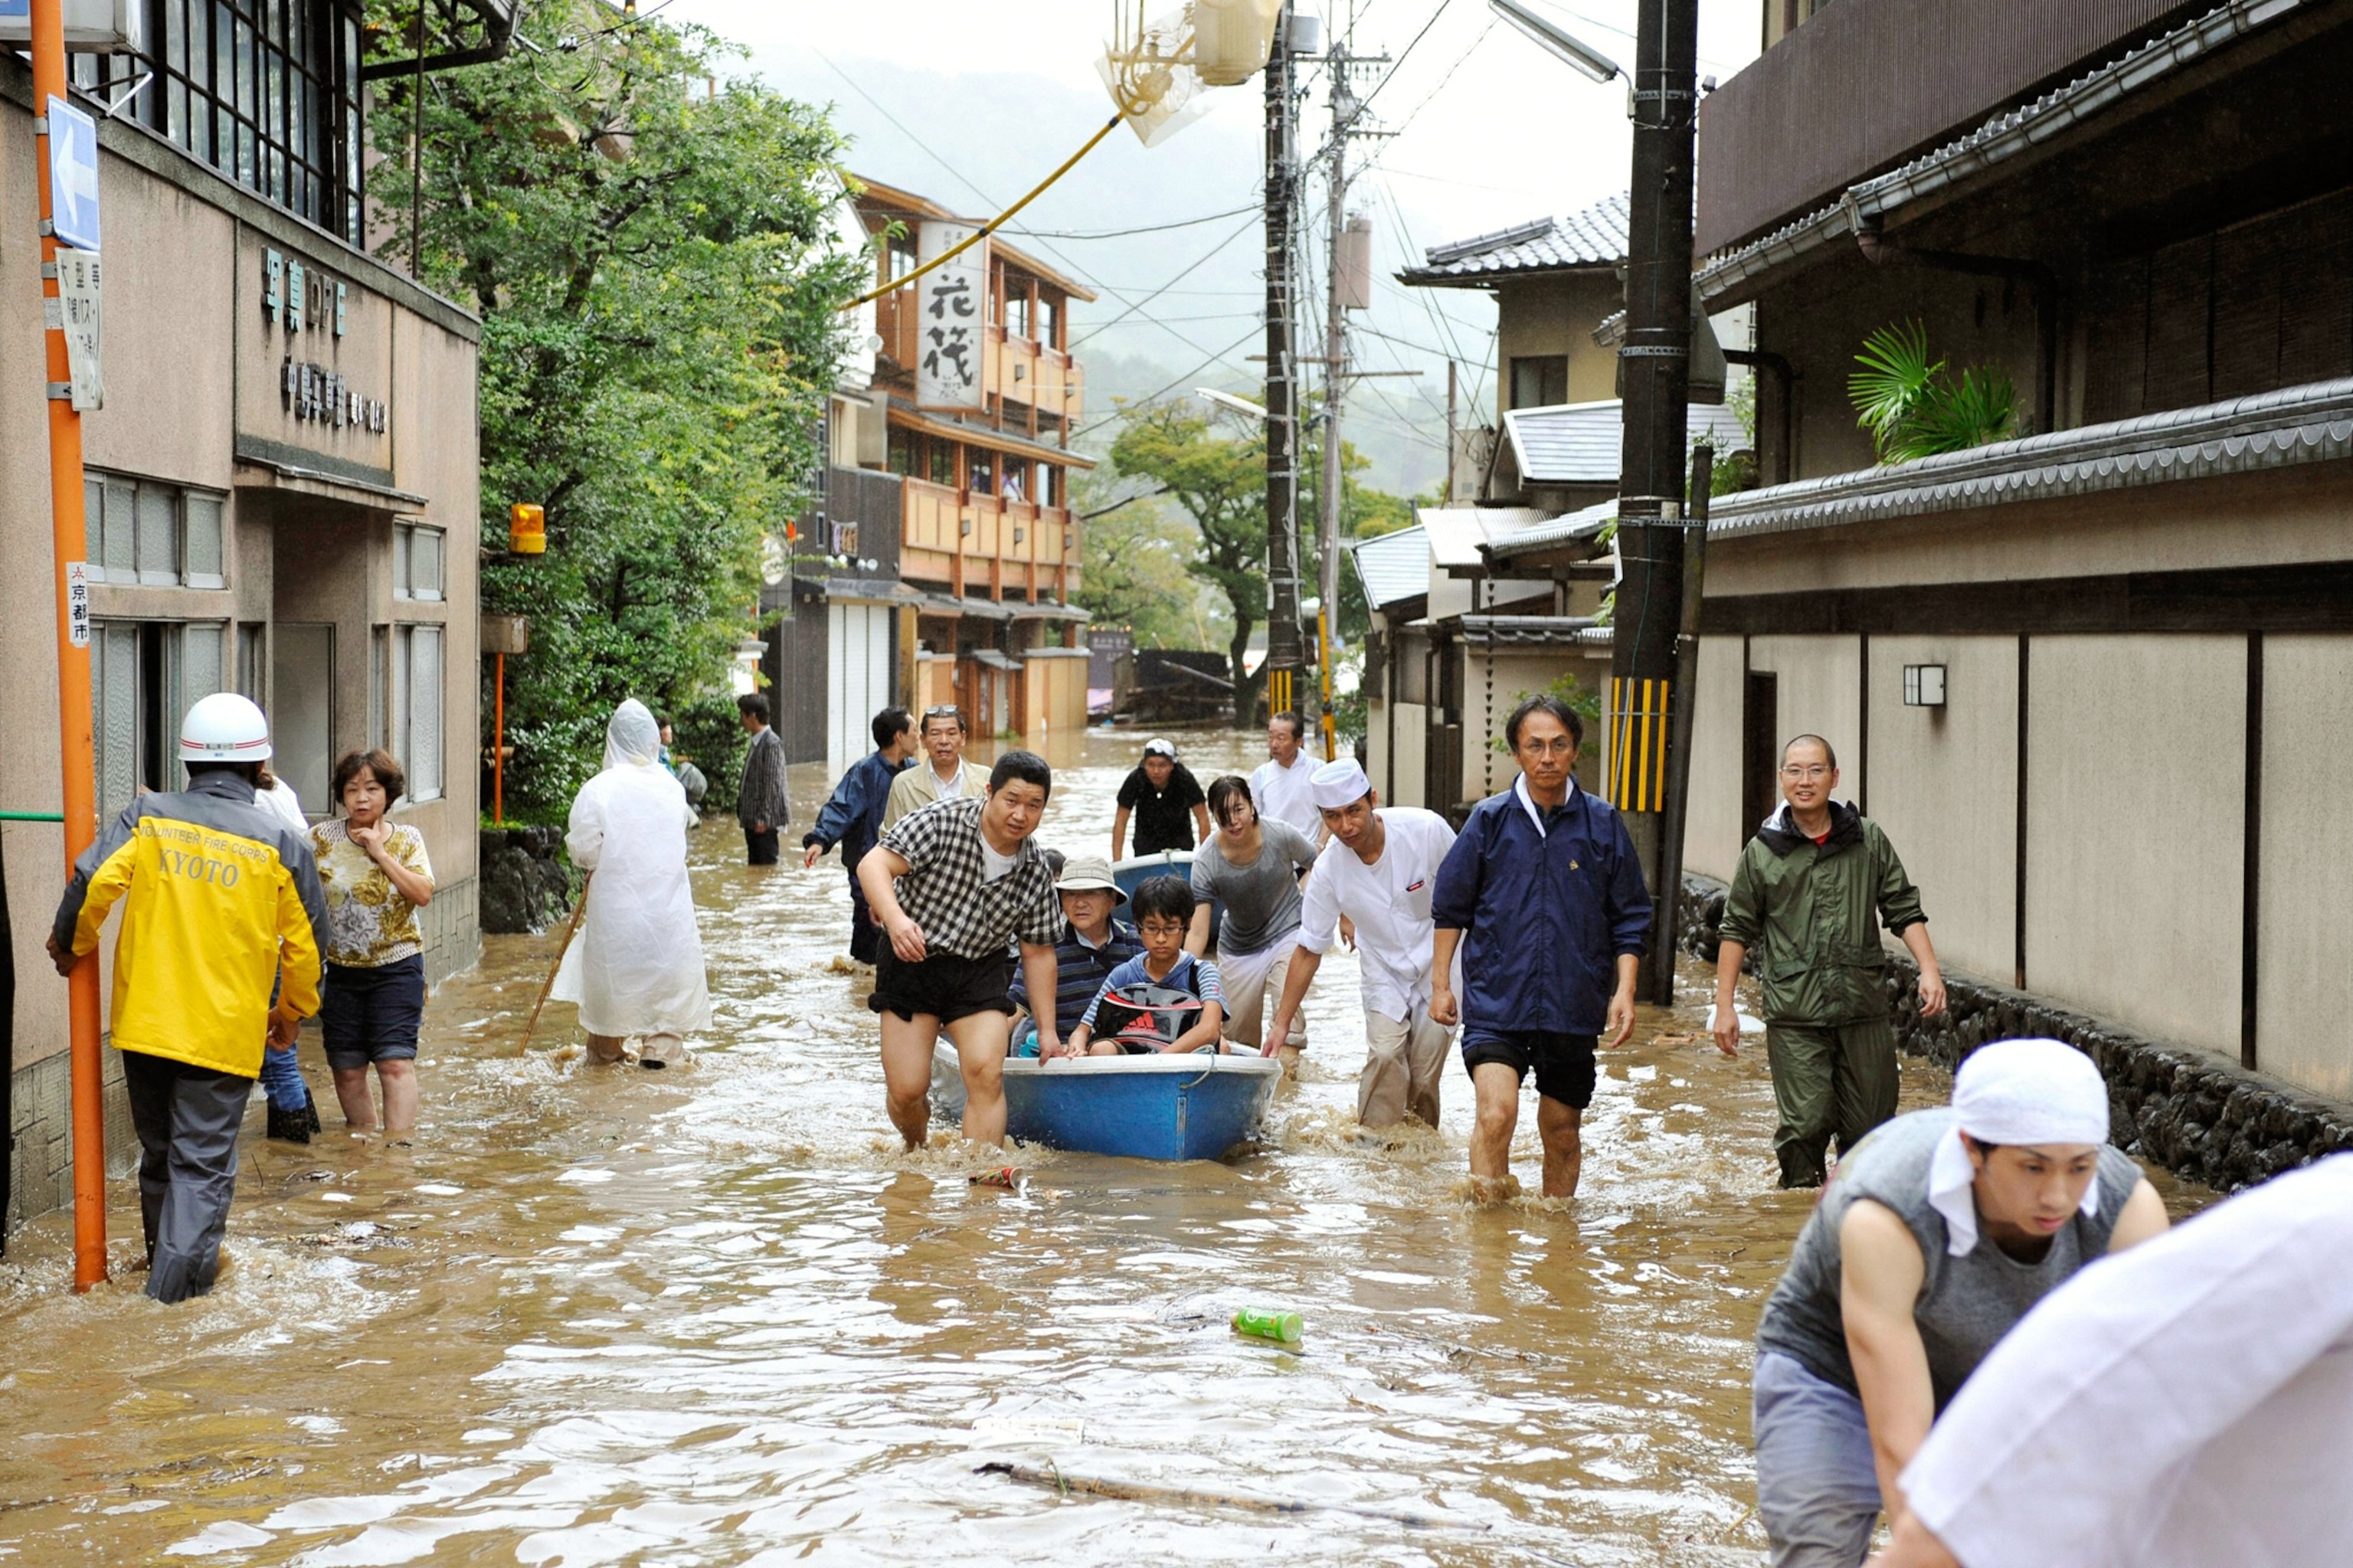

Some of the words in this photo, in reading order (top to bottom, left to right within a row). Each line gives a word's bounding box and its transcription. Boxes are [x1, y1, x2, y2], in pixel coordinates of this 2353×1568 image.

[71, 584, 87, 640] 京都市
[139, 825, 201, 845] VOUNTEER
[203, 836, 227, 852] FIRE
[231, 843, 268, 863] CORPS
[159, 848, 239, 887] KYOTO
